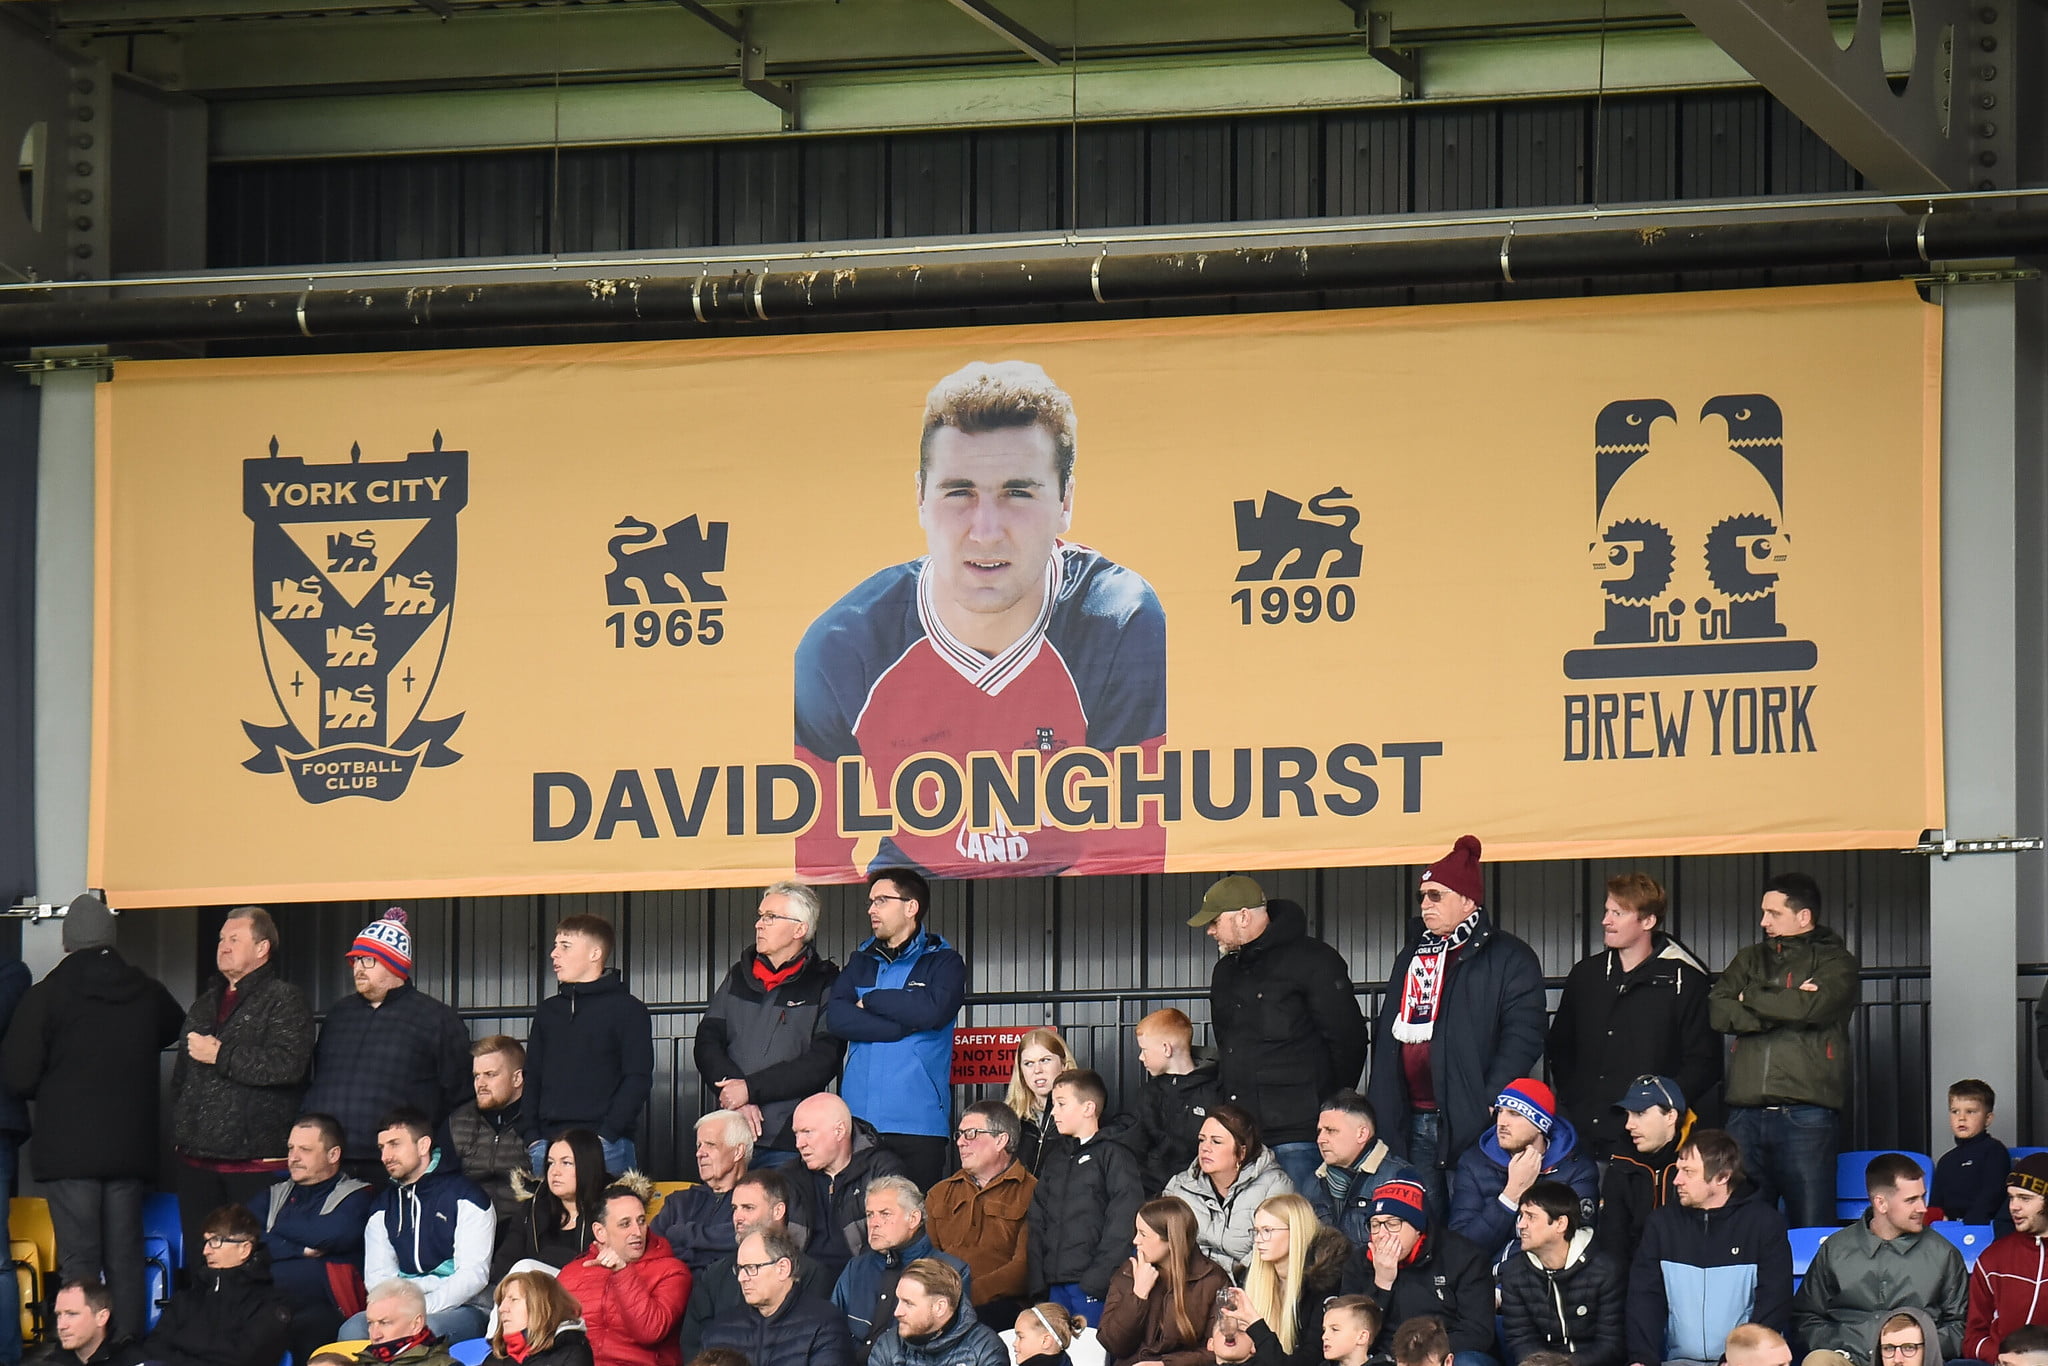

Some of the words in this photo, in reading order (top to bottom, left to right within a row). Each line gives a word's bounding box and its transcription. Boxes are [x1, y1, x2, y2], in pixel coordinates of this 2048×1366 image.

[261, 481, 358, 507] YORK
[366, 475, 449, 504] CITY
[1231, 583, 1356, 625] 1990
[605, 608, 725, 649] 1965
[1563, 689, 1695, 762] BREW
[1703, 684, 1818, 756] YORK
[302, 760, 403, 776] FOOTBALL
[325, 776, 378, 790] CLUB
[532, 763, 817, 843] DAVID
[841, 740, 1445, 832] LONGHURST
[362, 923, 411, 957] dBa
[954, 1034, 997, 1045] SAFETY
[963, 1049, 993, 1061] NOT
[997, 1049, 1017, 1061] SIT
[951, 1065, 974, 1077] HIS
[1498, 1098, 1537, 1120] YORK
